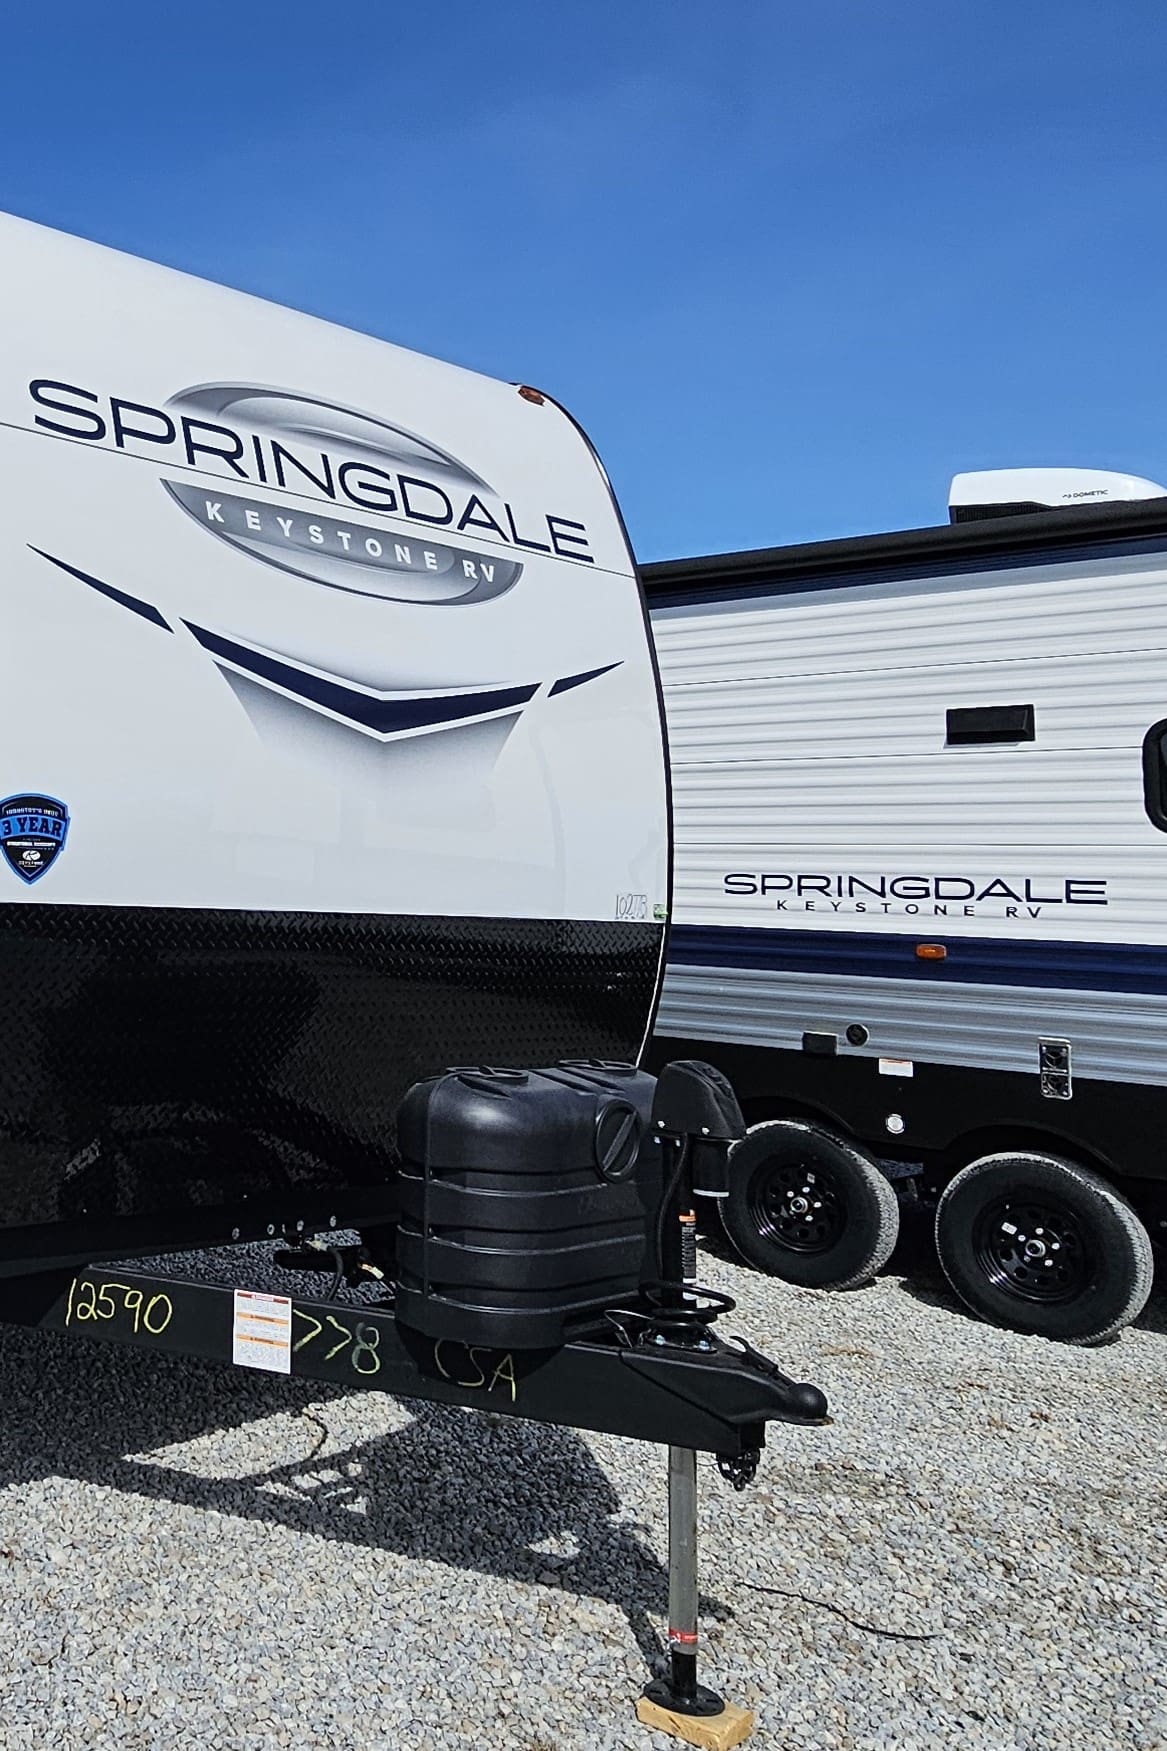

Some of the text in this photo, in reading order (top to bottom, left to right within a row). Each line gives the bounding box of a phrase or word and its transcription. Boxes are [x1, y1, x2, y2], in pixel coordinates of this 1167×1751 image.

[29, 379, 594, 564] SPRINGDALE
[1072, 489, 1109, 498] DOMETIC
[205, 501, 496, 583] KEYSTONE RV
[2, 817, 62, 838] 3 YEAR
[723, 874, 1108, 905] SPRINGDALE
[777, 900, 1042, 919] KEYSTONE RV
[65, 1278, 173, 1335] 12590
[435, 1338, 517, 1402] CSA
